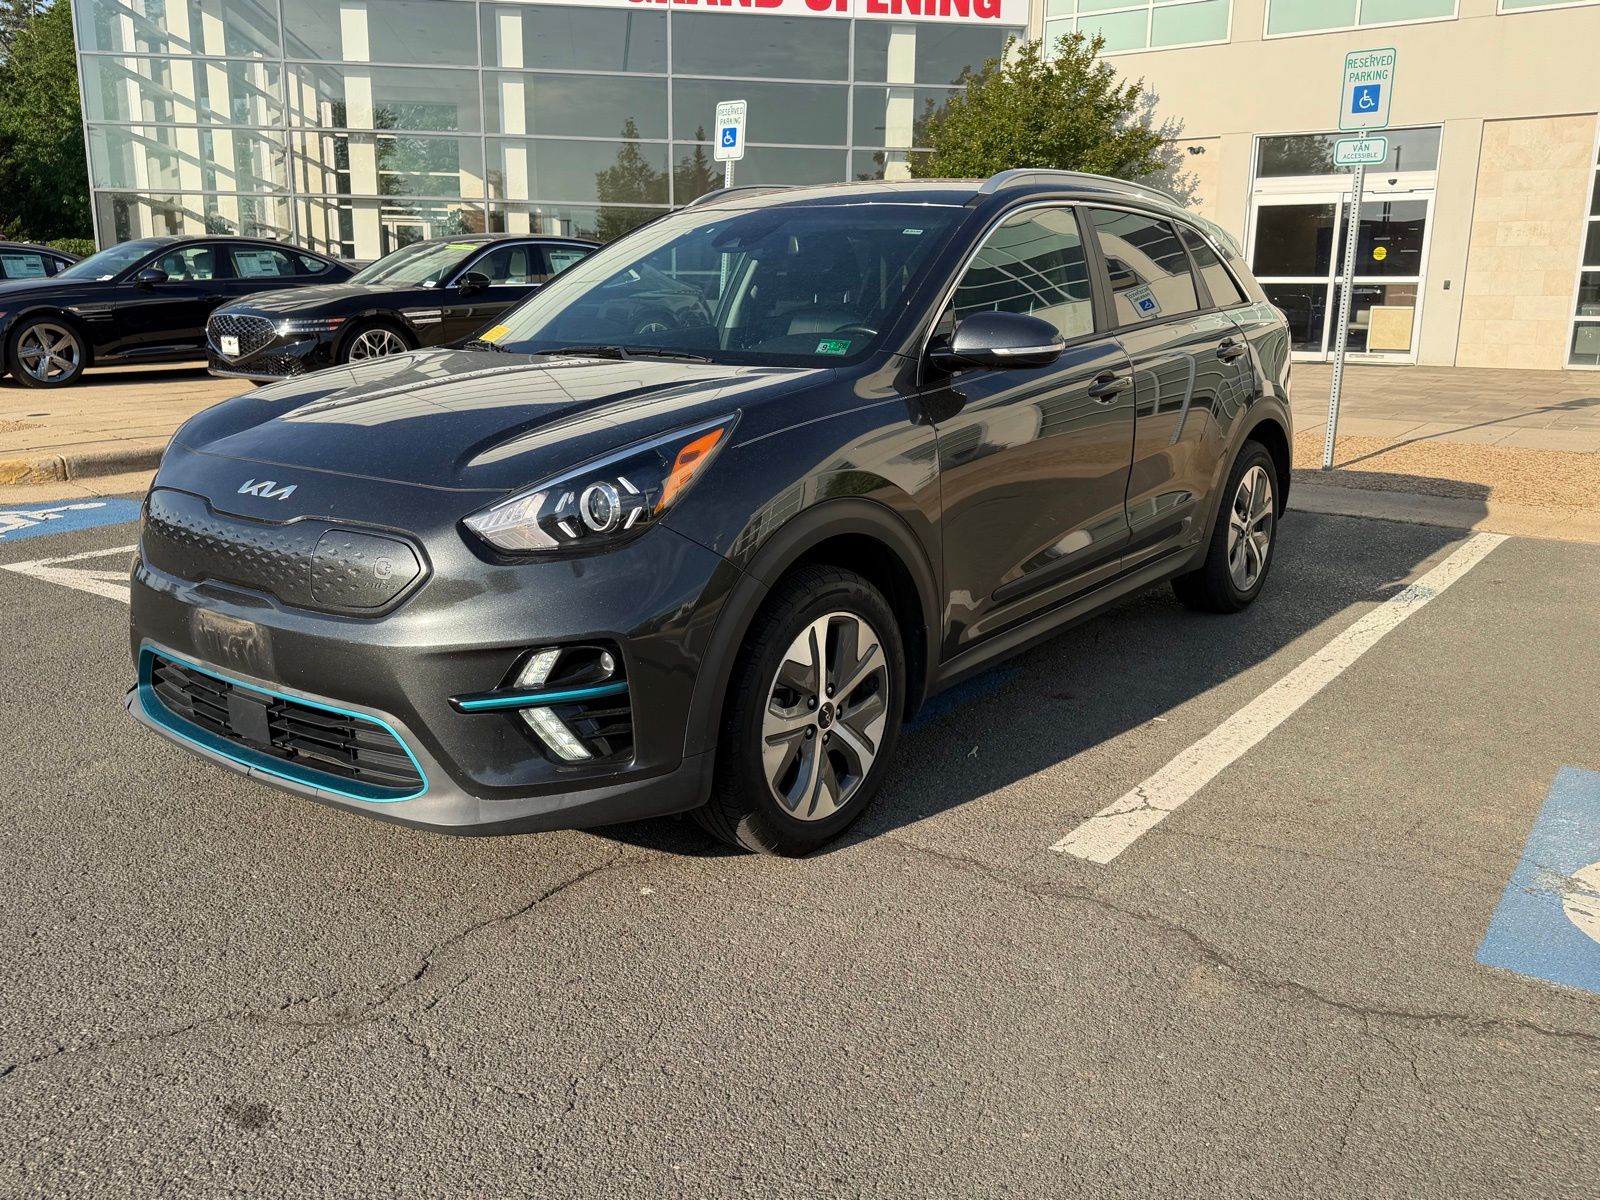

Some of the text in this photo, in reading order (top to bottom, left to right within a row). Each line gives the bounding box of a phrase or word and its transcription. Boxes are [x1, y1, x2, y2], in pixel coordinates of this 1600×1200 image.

[1347, 55, 1393, 69] RESERVED
[1349, 70, 1389, 83] PARKING
[1353, 144, 1370, 152] VAN
[1342, 152, 1378, 160] ACCESSIBLE
[237, 478, 298, 501] KIA
